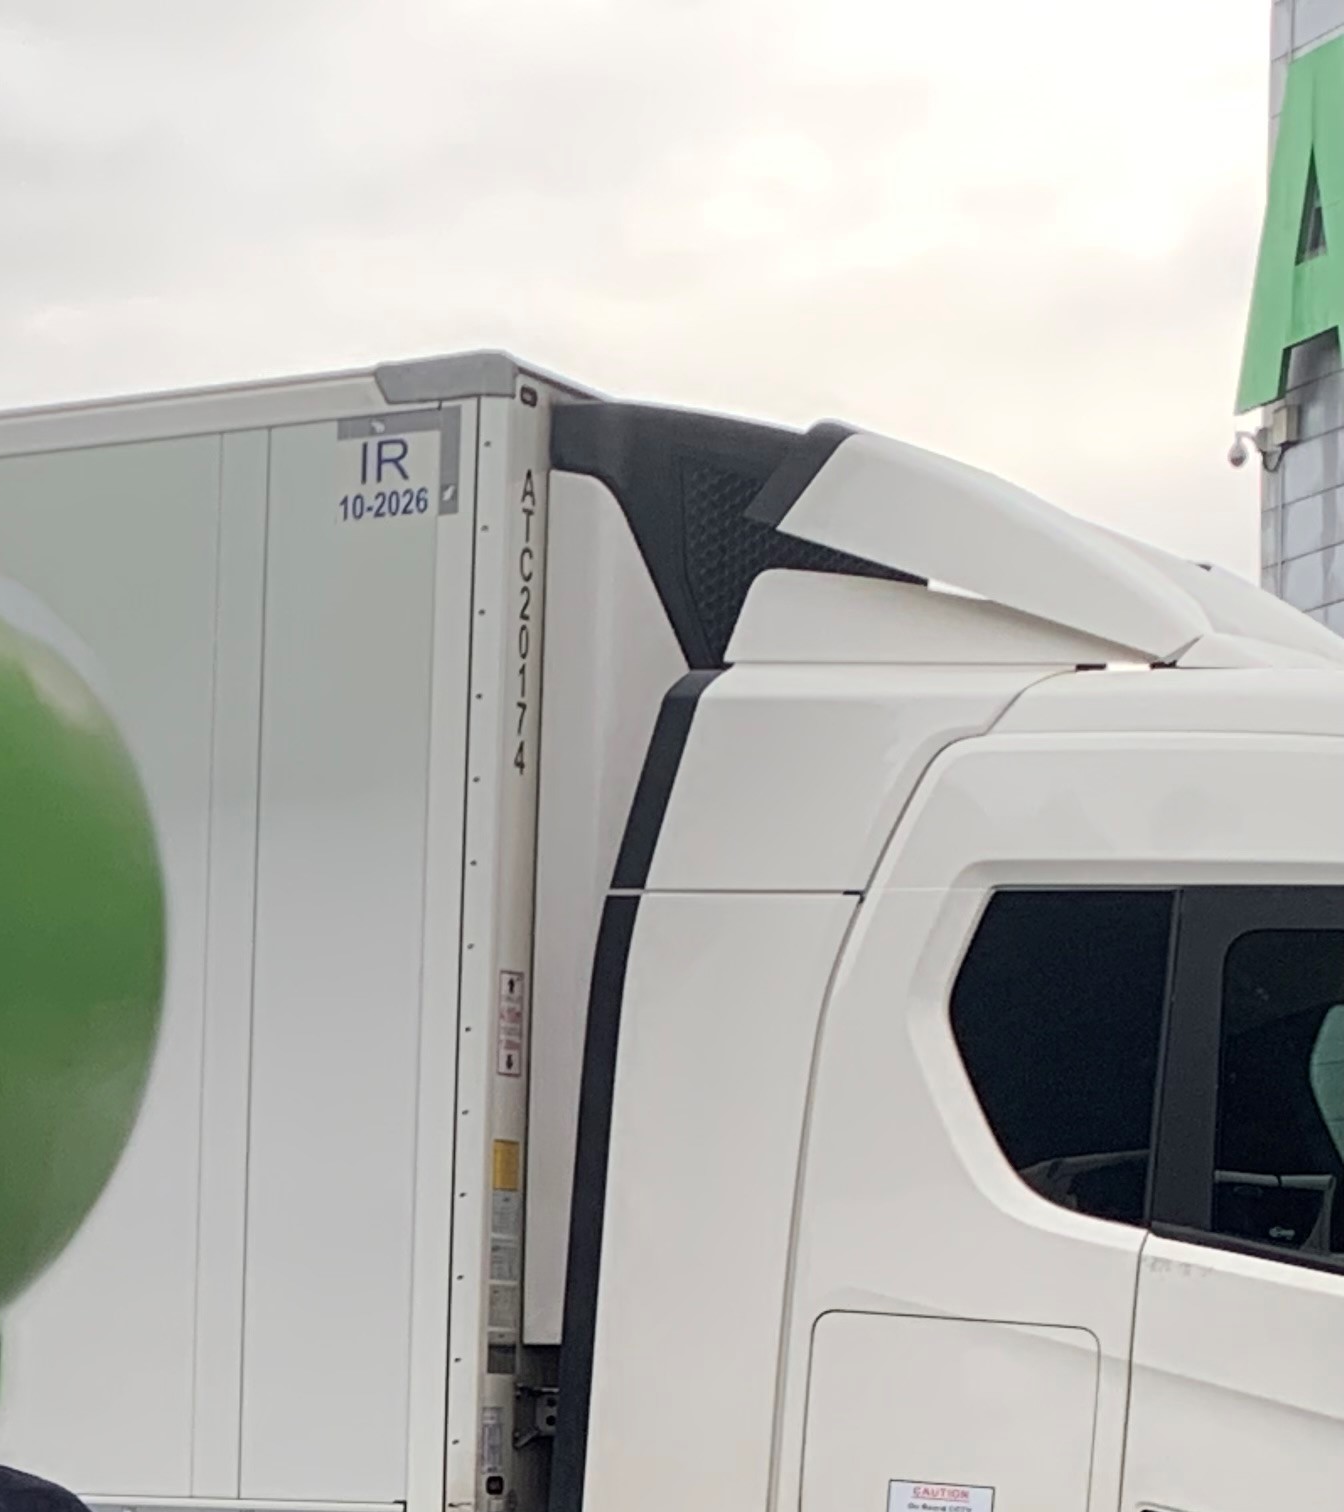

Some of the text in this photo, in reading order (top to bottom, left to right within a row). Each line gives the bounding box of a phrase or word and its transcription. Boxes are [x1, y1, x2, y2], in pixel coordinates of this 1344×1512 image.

[361, 437, 410, 485] IR
[339, 487, 429, 522] 10-2026
[514, 469, 535, 775] ATC201174
[914, 1487, 970, 1499] CAUTION
